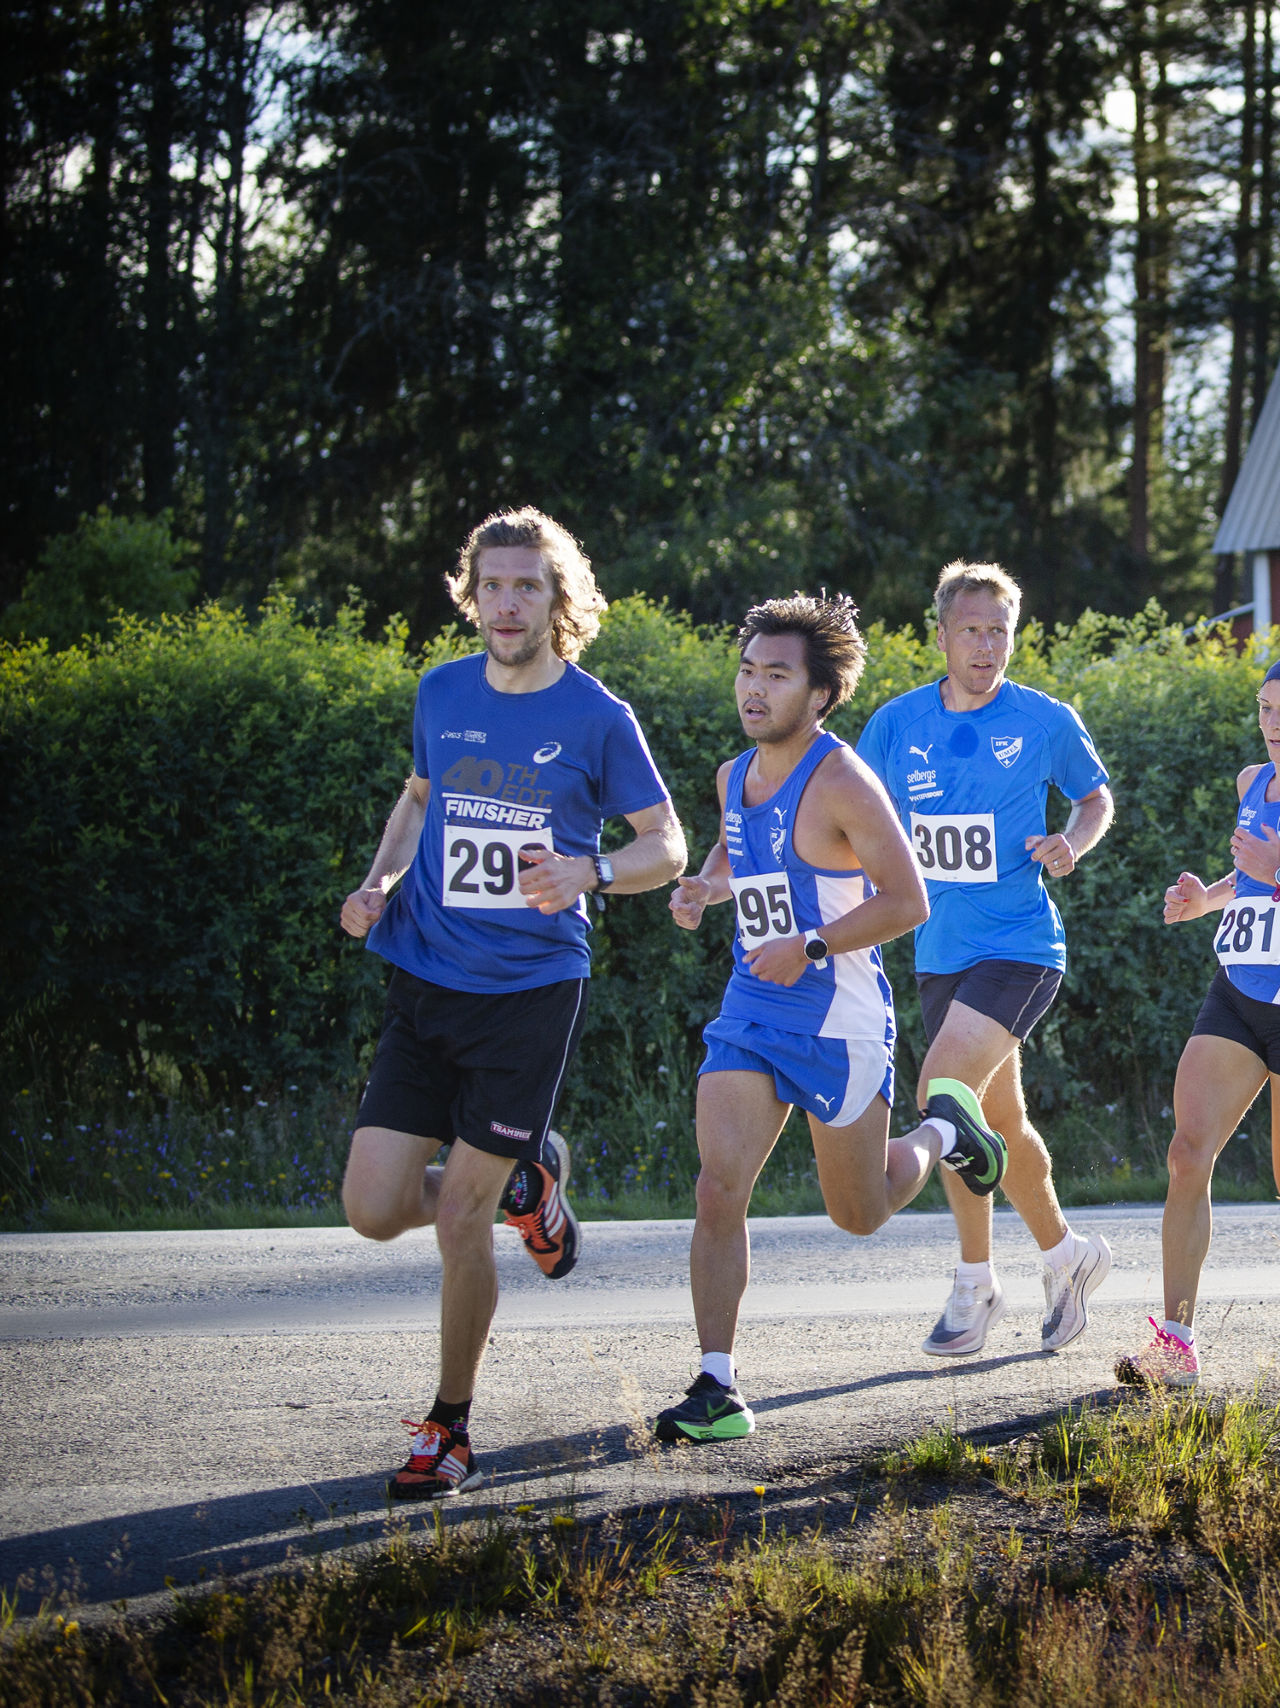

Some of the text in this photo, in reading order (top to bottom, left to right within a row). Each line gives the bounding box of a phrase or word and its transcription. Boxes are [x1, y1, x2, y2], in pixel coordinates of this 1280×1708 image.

[441, 756, 540, 796] 40 TH
[906, 769, 937, 784] selbergs
[446, 799, 547, 829] FINISHER
[914, 824, 993, 872] 308
[739, 884, 793, 938] 95
[1216, 906, 1276, 954] 281
